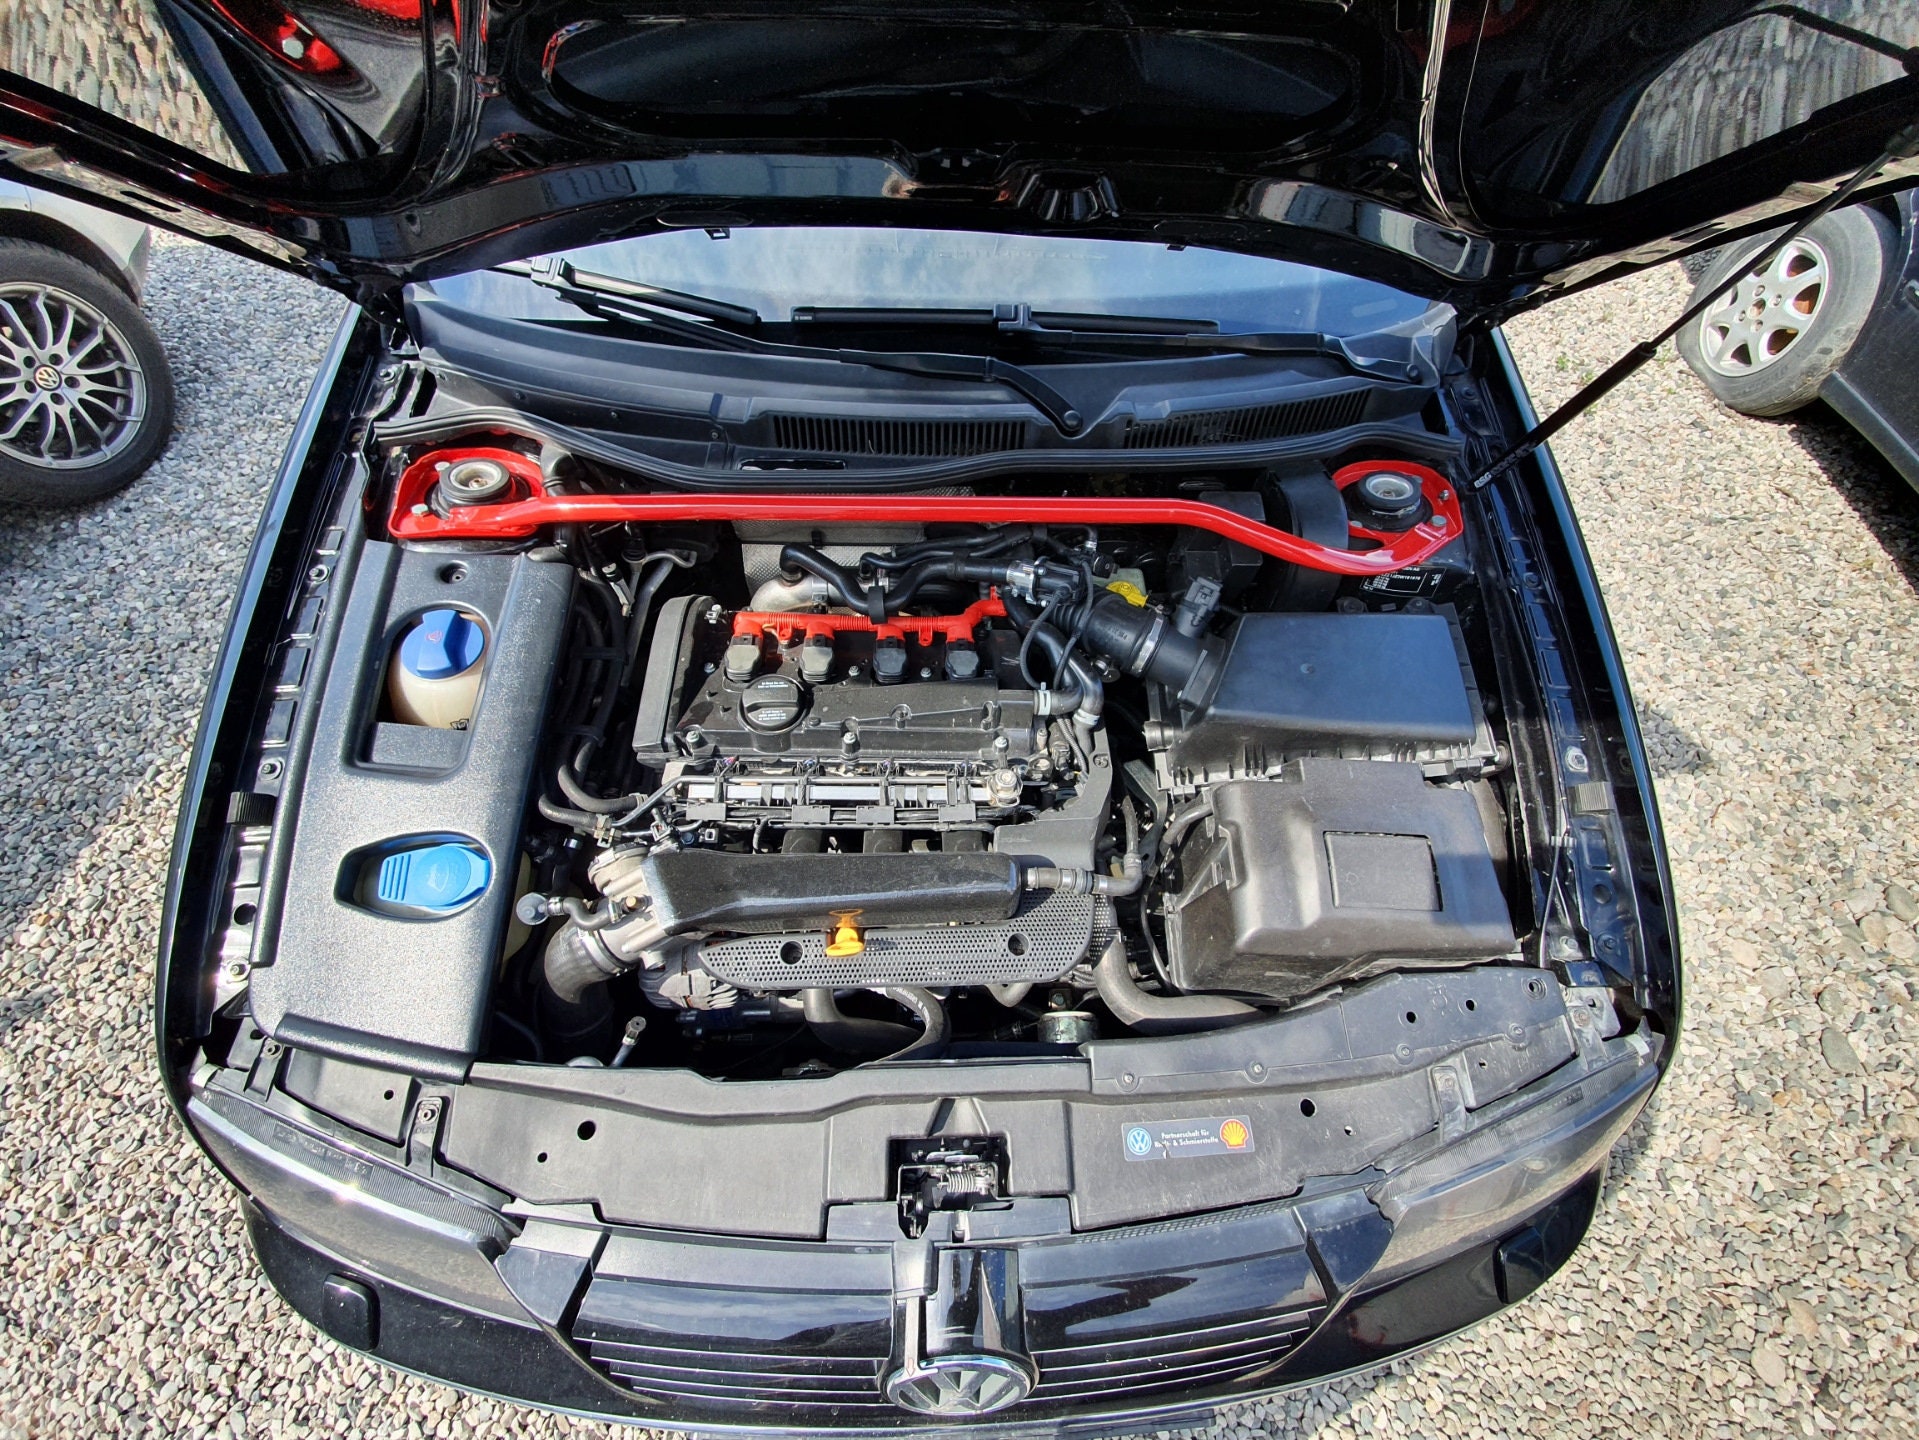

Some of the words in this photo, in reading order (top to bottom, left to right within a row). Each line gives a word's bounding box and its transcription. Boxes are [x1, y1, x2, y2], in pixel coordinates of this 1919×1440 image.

[35, 366, 61, 390] VW
[1127, 1128, 1151, 1155] VW
[1161, 1130, 1200, 1139] Partnerschaft
[1179, 1136, 1219, 1146] Schmierstoffe
[887, 1355, 1031, 1416] VW
